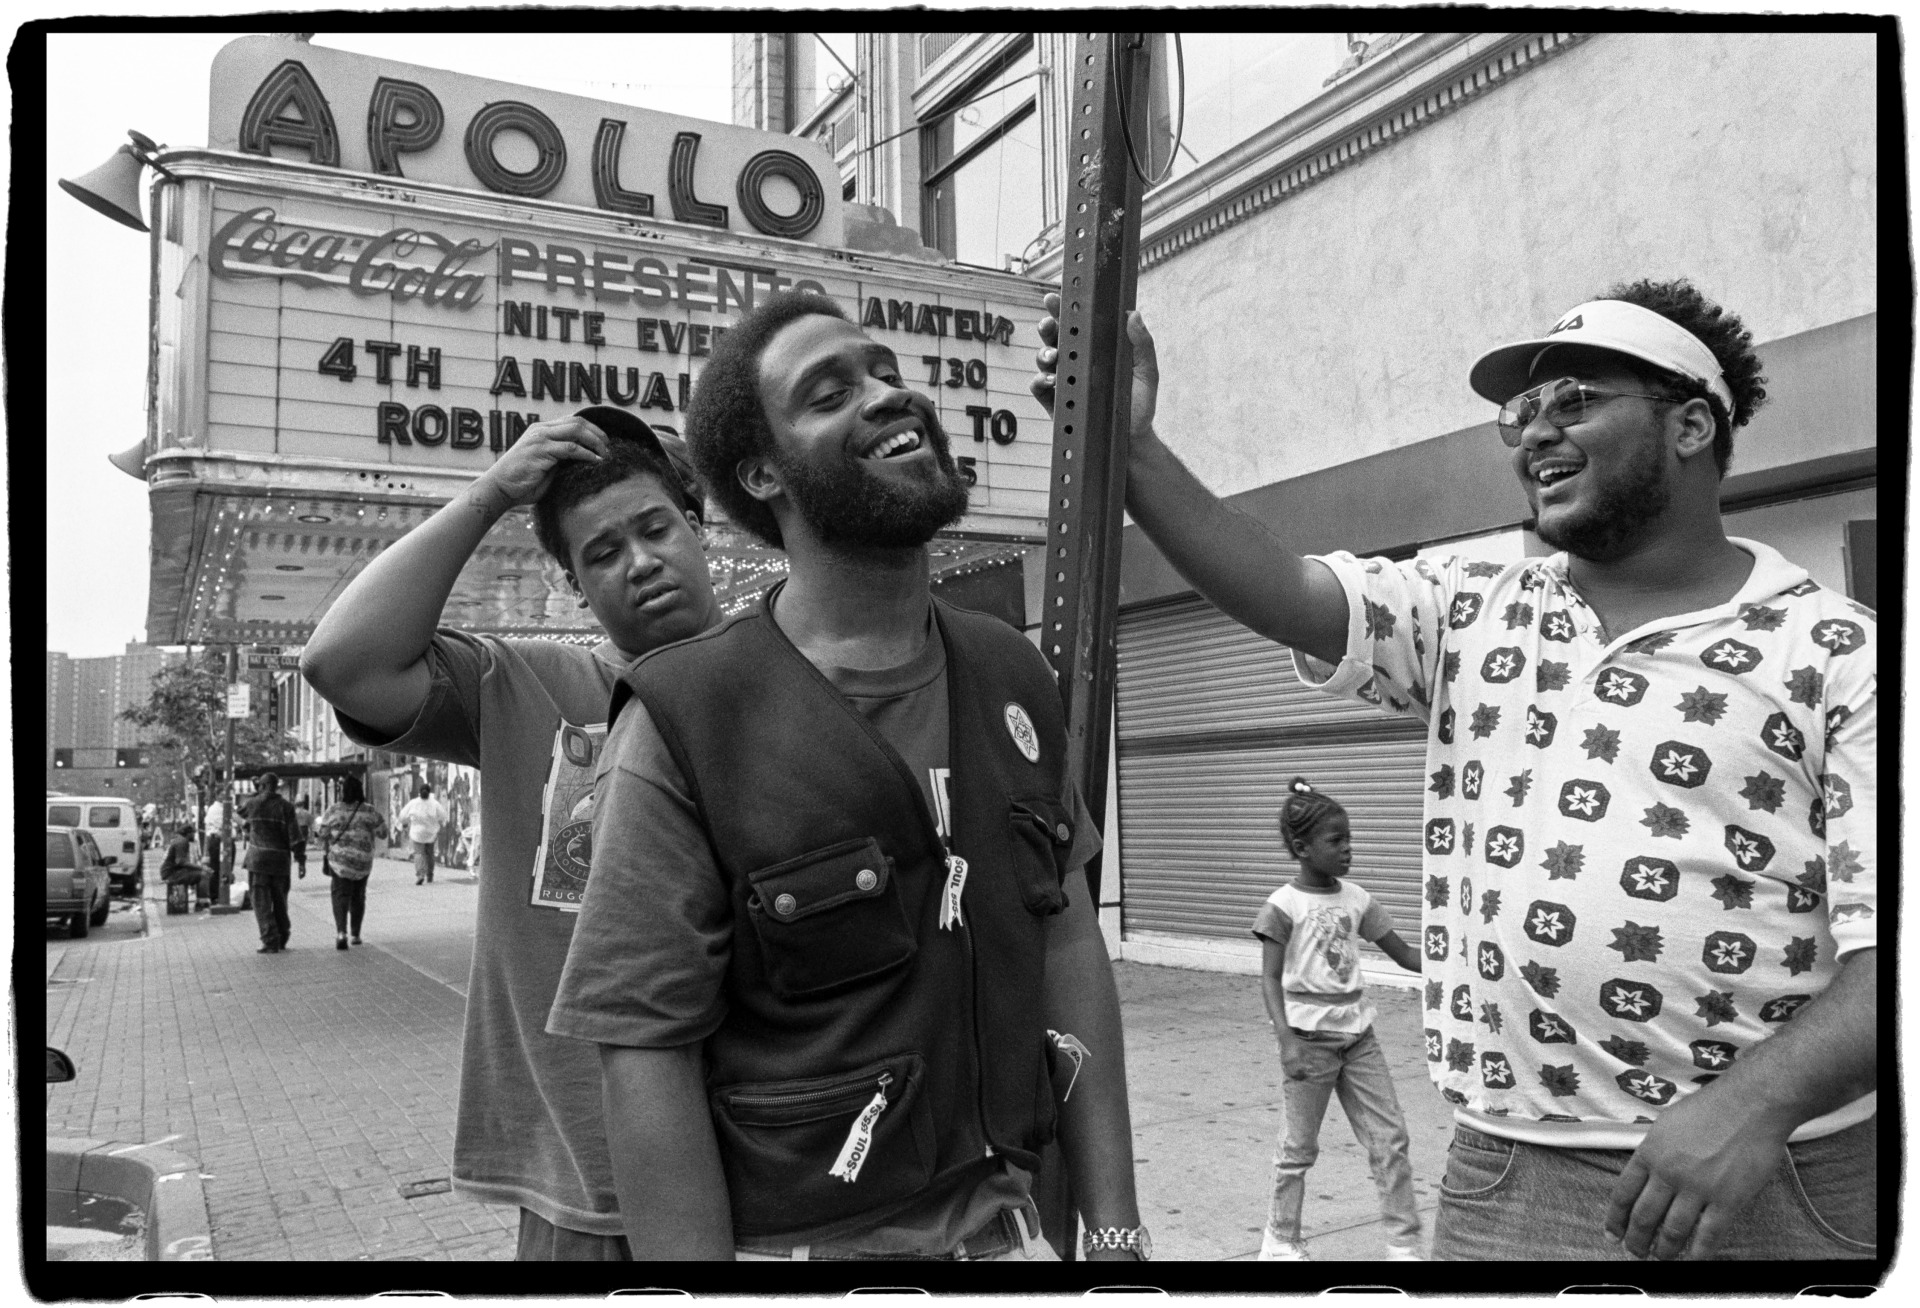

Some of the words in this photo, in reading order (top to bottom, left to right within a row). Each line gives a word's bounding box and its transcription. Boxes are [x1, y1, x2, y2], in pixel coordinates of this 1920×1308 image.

[239, 58, 825, 239] APOLLO
[209, 206, 498, 311] Coca-Cola
[863, 296, 1015, 347] AMATEUR
[318, 337, 441, 390] 4TH
[966, 405, 1018, 446] TO
[504, 300, 605, 347] NITE
[922, 355, 988, 389] 730
[950, 860, 964, 888] SOUL
